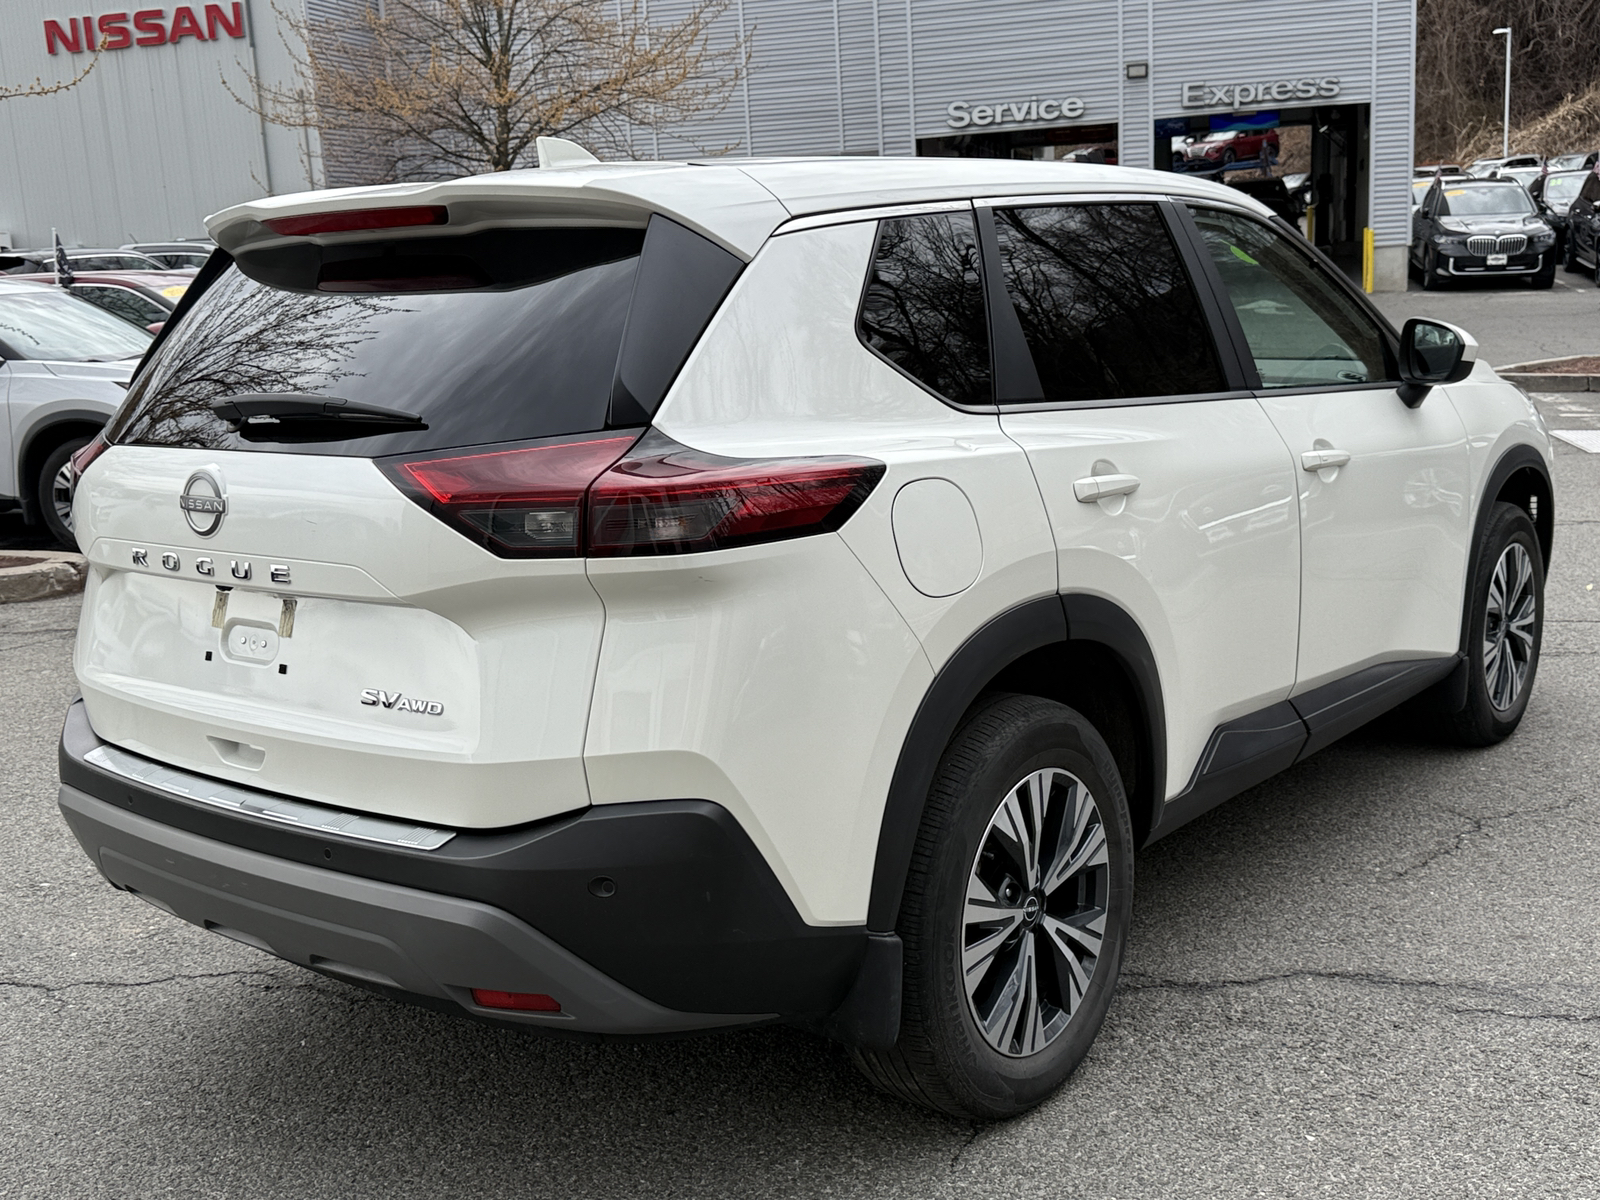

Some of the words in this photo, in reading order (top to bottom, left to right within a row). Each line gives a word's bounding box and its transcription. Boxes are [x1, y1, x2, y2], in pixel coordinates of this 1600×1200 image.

[44, 1, 245, 55] NISSAN
[1181, 77, 1341, 109] Express
[946, 96, 1086, 128] Service
[131, 547, 292, 584] ROGUE
[360, 687, 402, 709] SV
[397, 698, 444, 716] AWD
